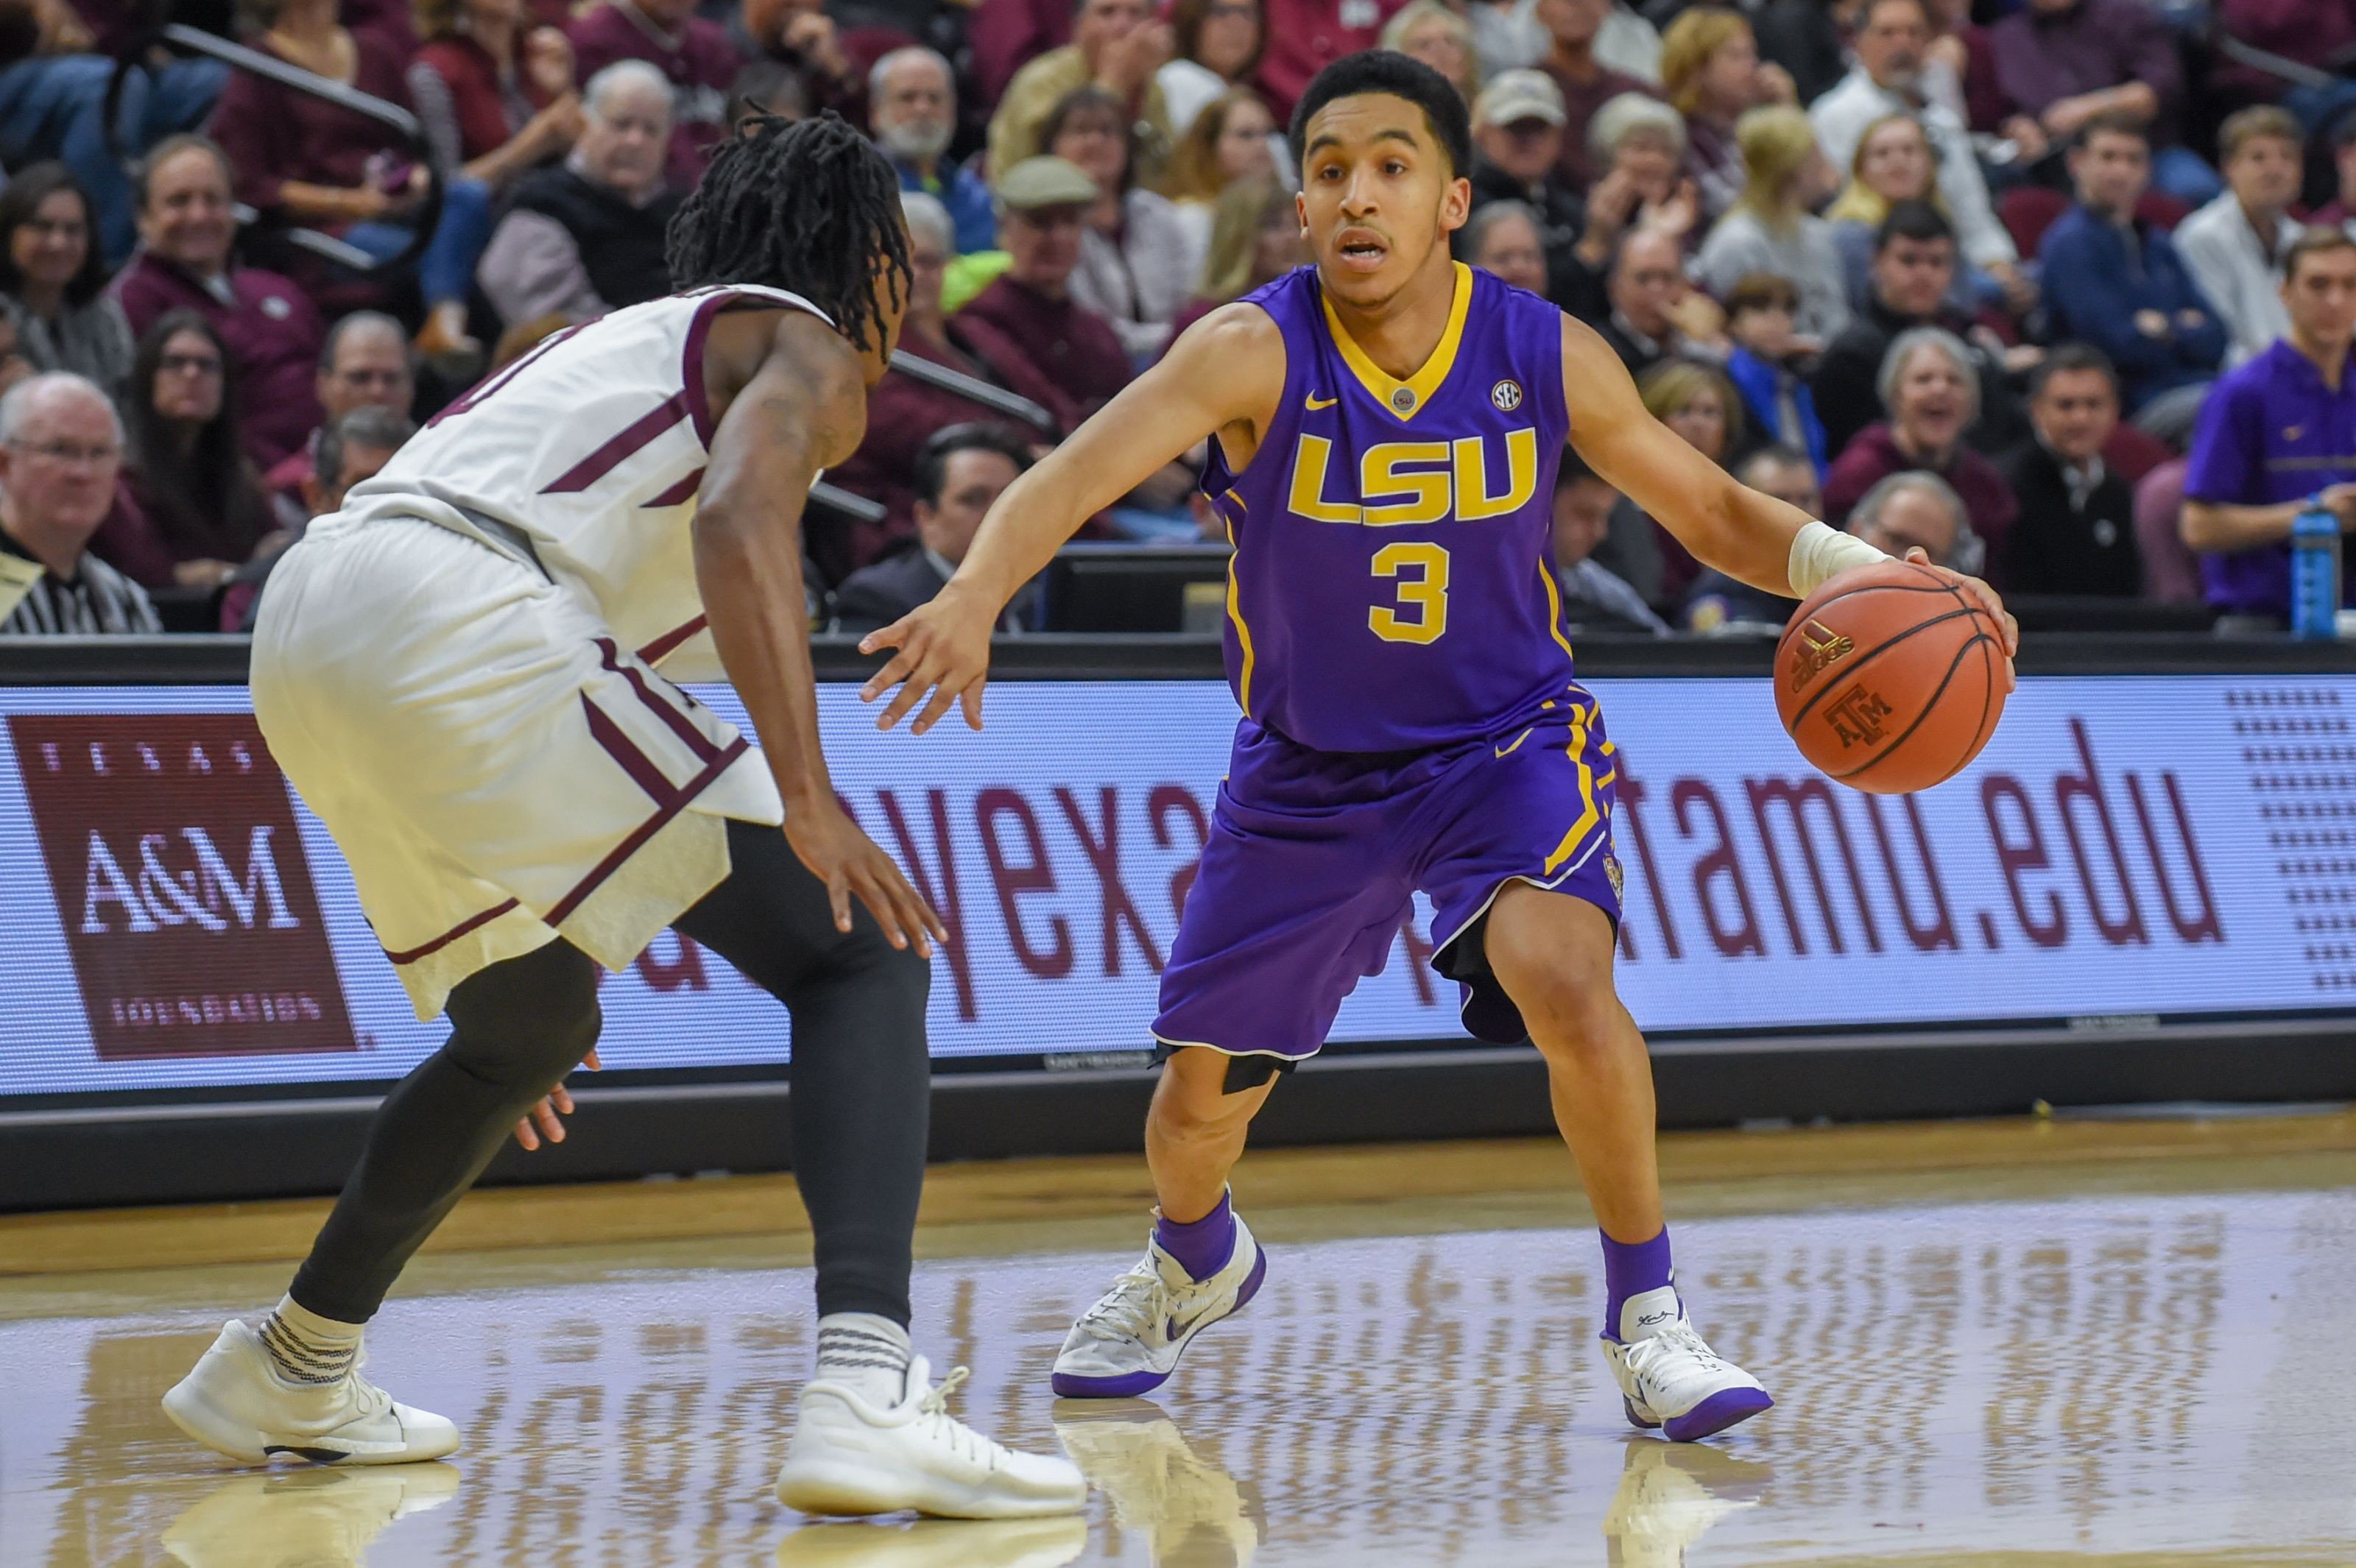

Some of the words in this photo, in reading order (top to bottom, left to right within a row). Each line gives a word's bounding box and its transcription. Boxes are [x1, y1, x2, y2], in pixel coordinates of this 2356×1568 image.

[1393, 398, 1413, 406] LSU
[1495, 383, 1519, 409] SEC
[1287, 427, 1537, 527] LSU
[1368, 542, 1450, 645] 3
[80, 824, 300, 934] A&M
